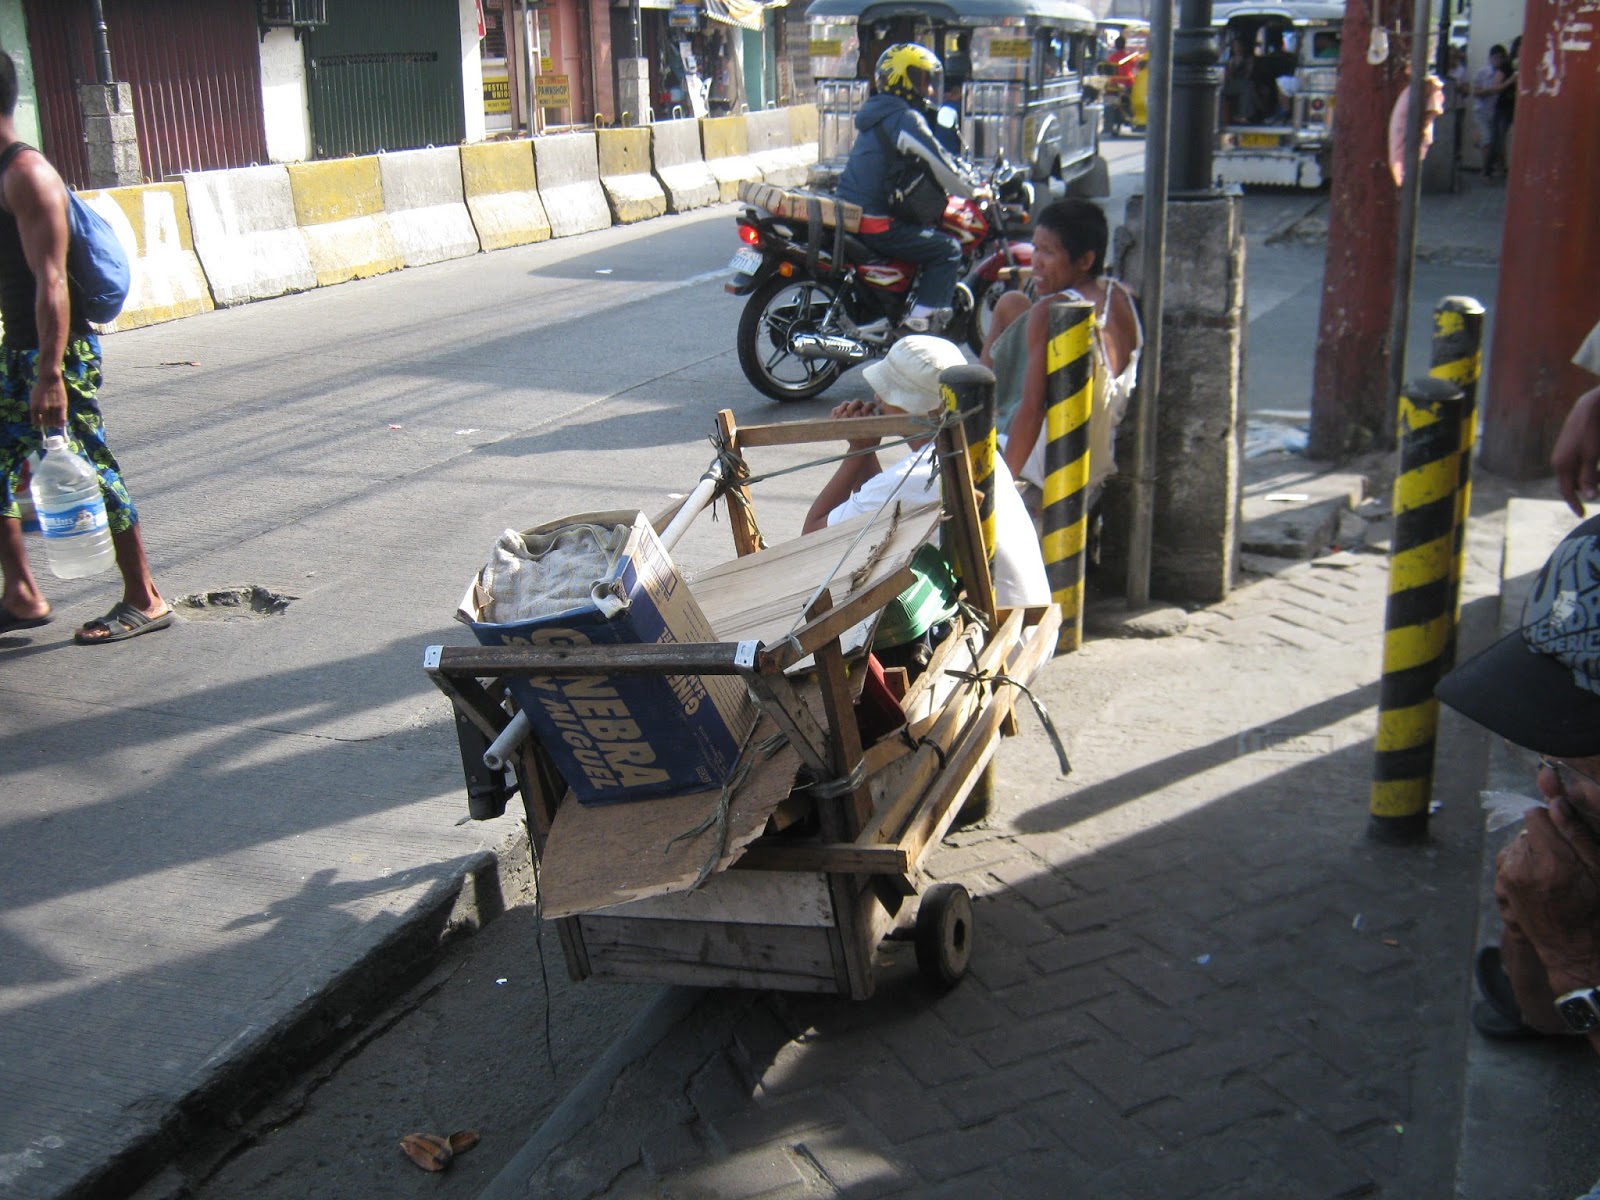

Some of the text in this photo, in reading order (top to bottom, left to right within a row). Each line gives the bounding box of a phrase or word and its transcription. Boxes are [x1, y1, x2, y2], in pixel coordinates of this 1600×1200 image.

[483, 84, 509, 92] WESTER
[492, 91, 510, 99] UNIO
[531, 628, 671, 787] GNEBRA
[539, 697, 618, 790] MIGUEL
